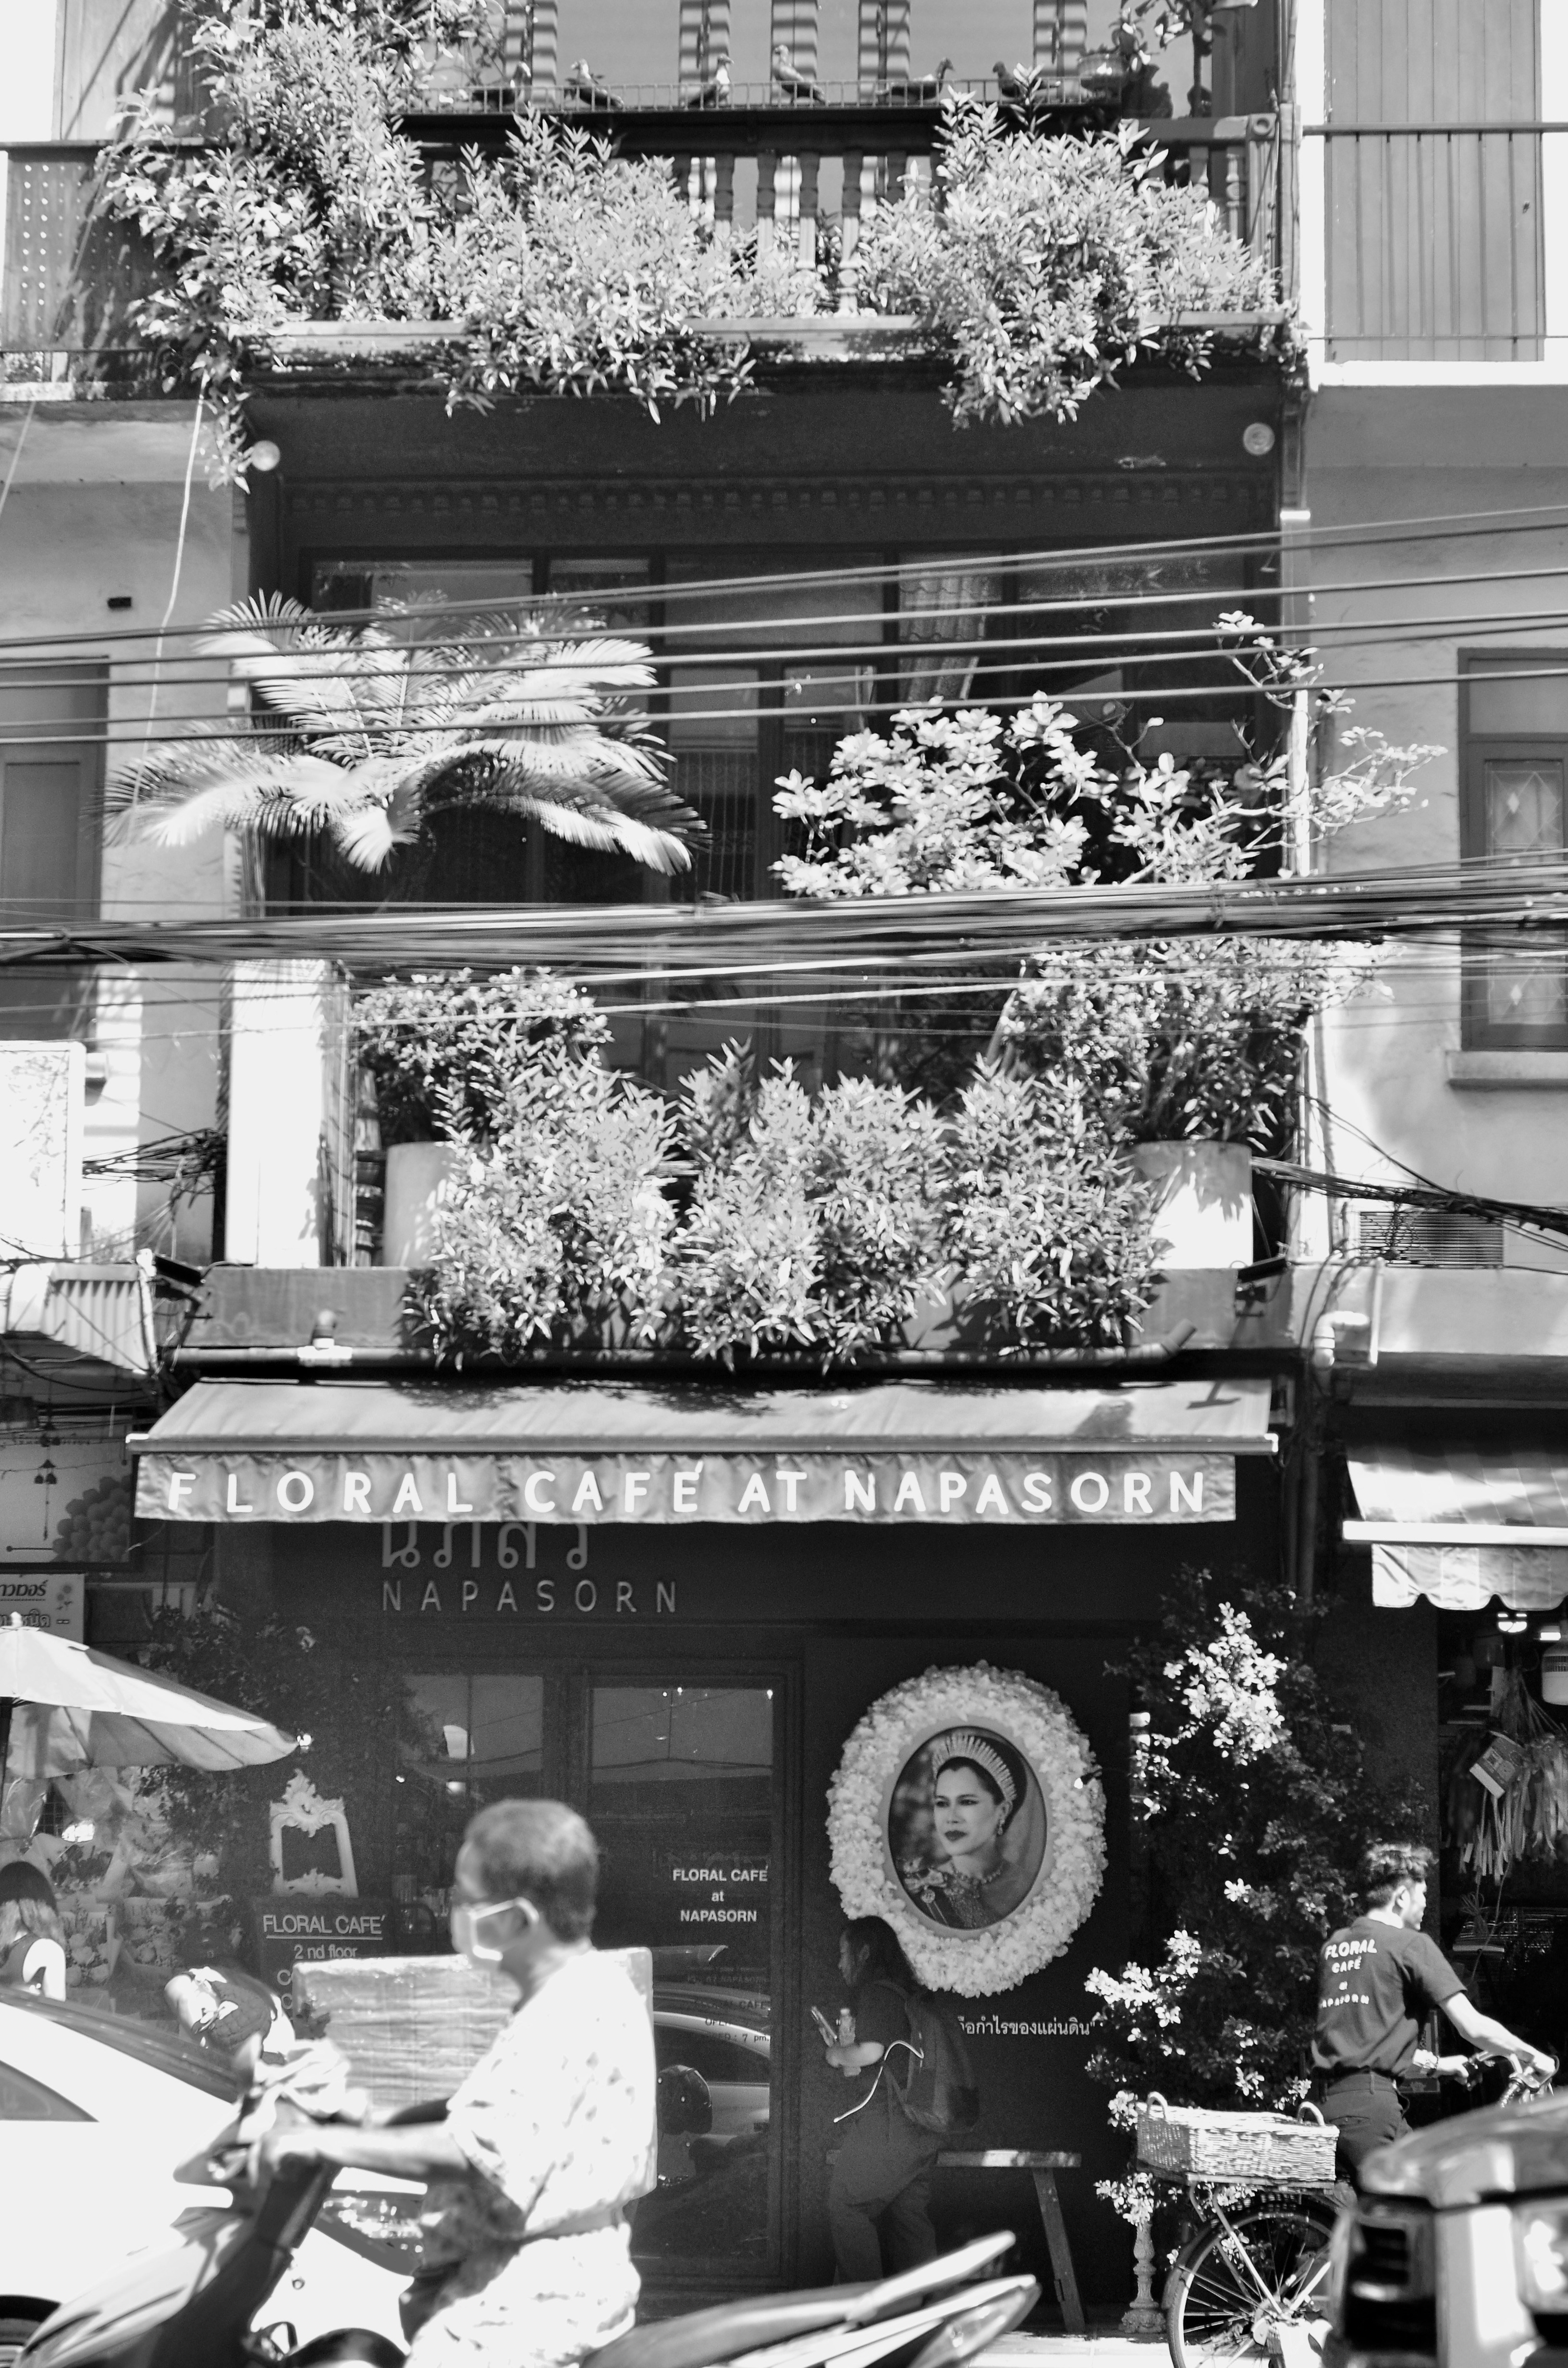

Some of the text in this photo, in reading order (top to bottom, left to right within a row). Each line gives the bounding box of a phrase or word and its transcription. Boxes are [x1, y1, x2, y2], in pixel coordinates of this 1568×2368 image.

[168, 1471, 473, 1513] FLORAL
[737, 1470, 807, 1513] AT
[845, 1471, 1203, 1514] NAPASORN
[383, 1579, 675, 1612] NAPASORN
[673, 1868, 727, 1881] FLORAL
[711, 1890, 724, 1902] at
[263, 1914, 333, 1933] FLORAL
[680, 1909, 757, 1922] NAPASORN
[294, 1944, 358, 1959] 2 nd floor
[1324, 1939, 1377, 1961] FLORAL
